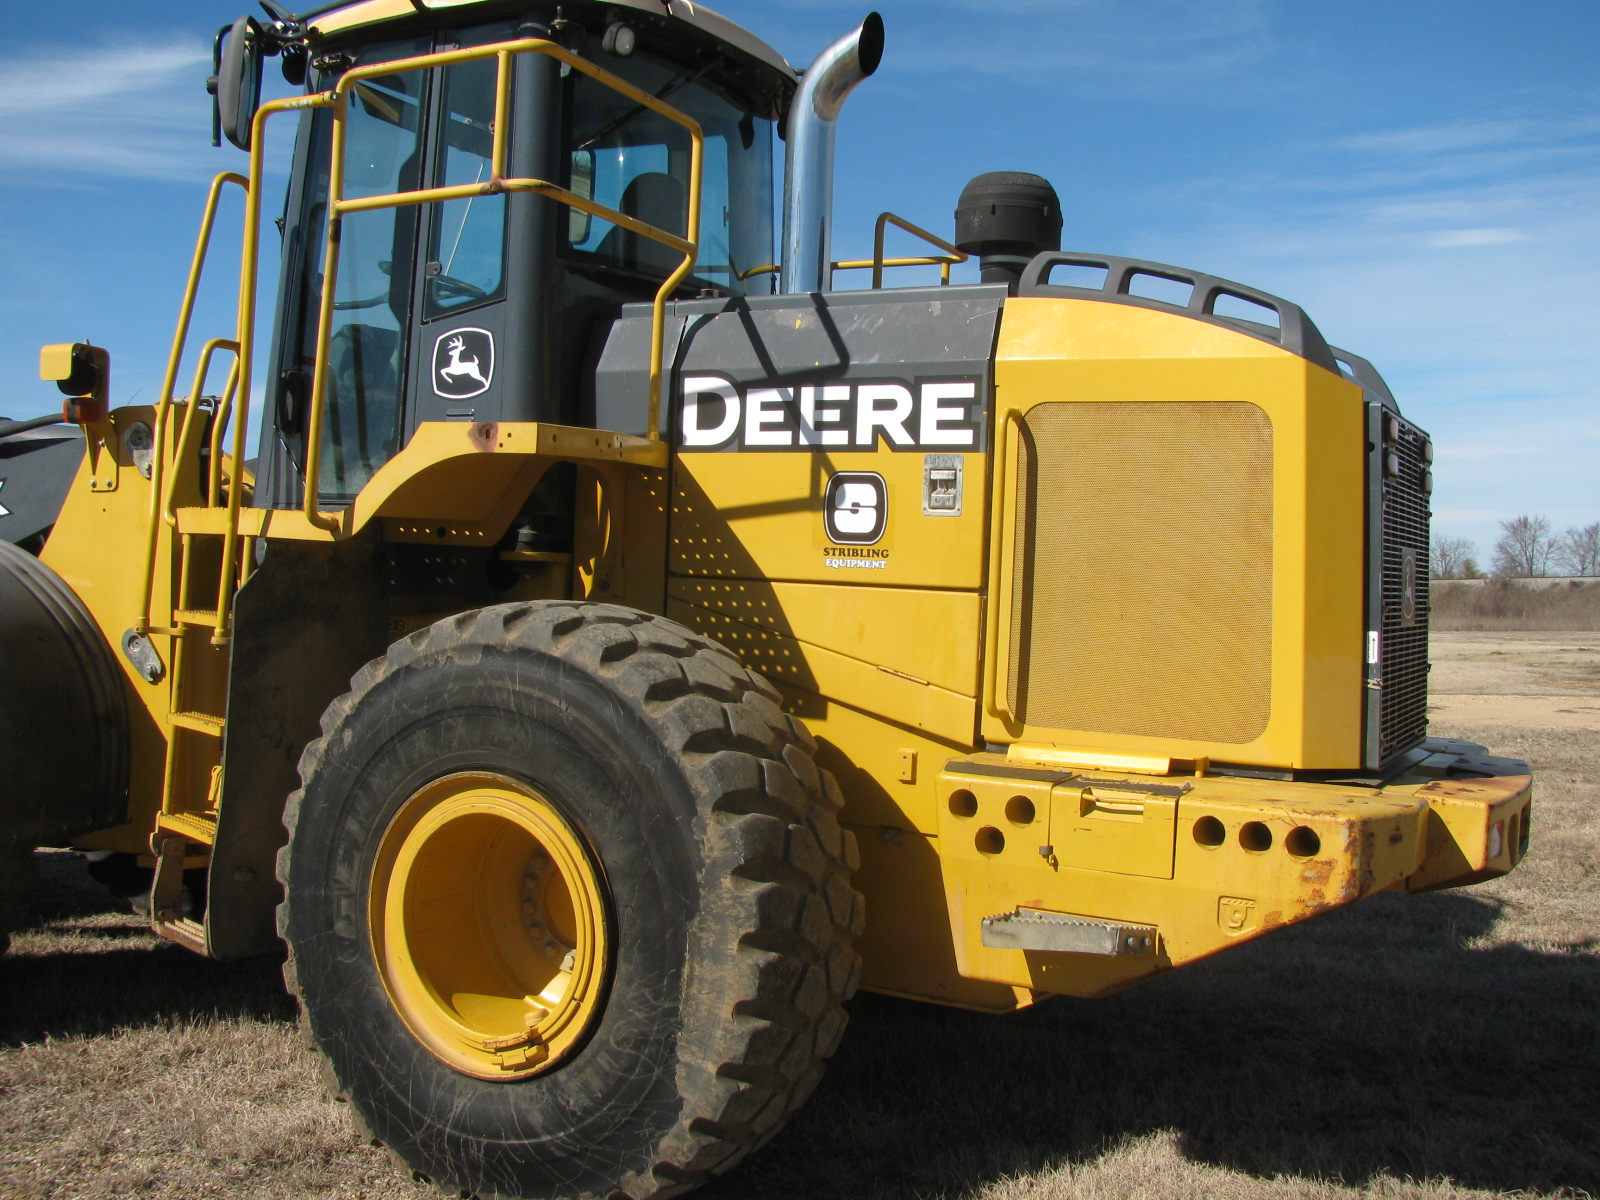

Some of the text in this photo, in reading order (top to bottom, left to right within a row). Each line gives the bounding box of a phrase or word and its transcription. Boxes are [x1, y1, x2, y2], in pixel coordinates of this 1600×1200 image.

[682, 376, 975, 446] DEERE
[823, 547, 889, 558] STRIBLING
[825, 559, 887, 569] EQUIPMENT
